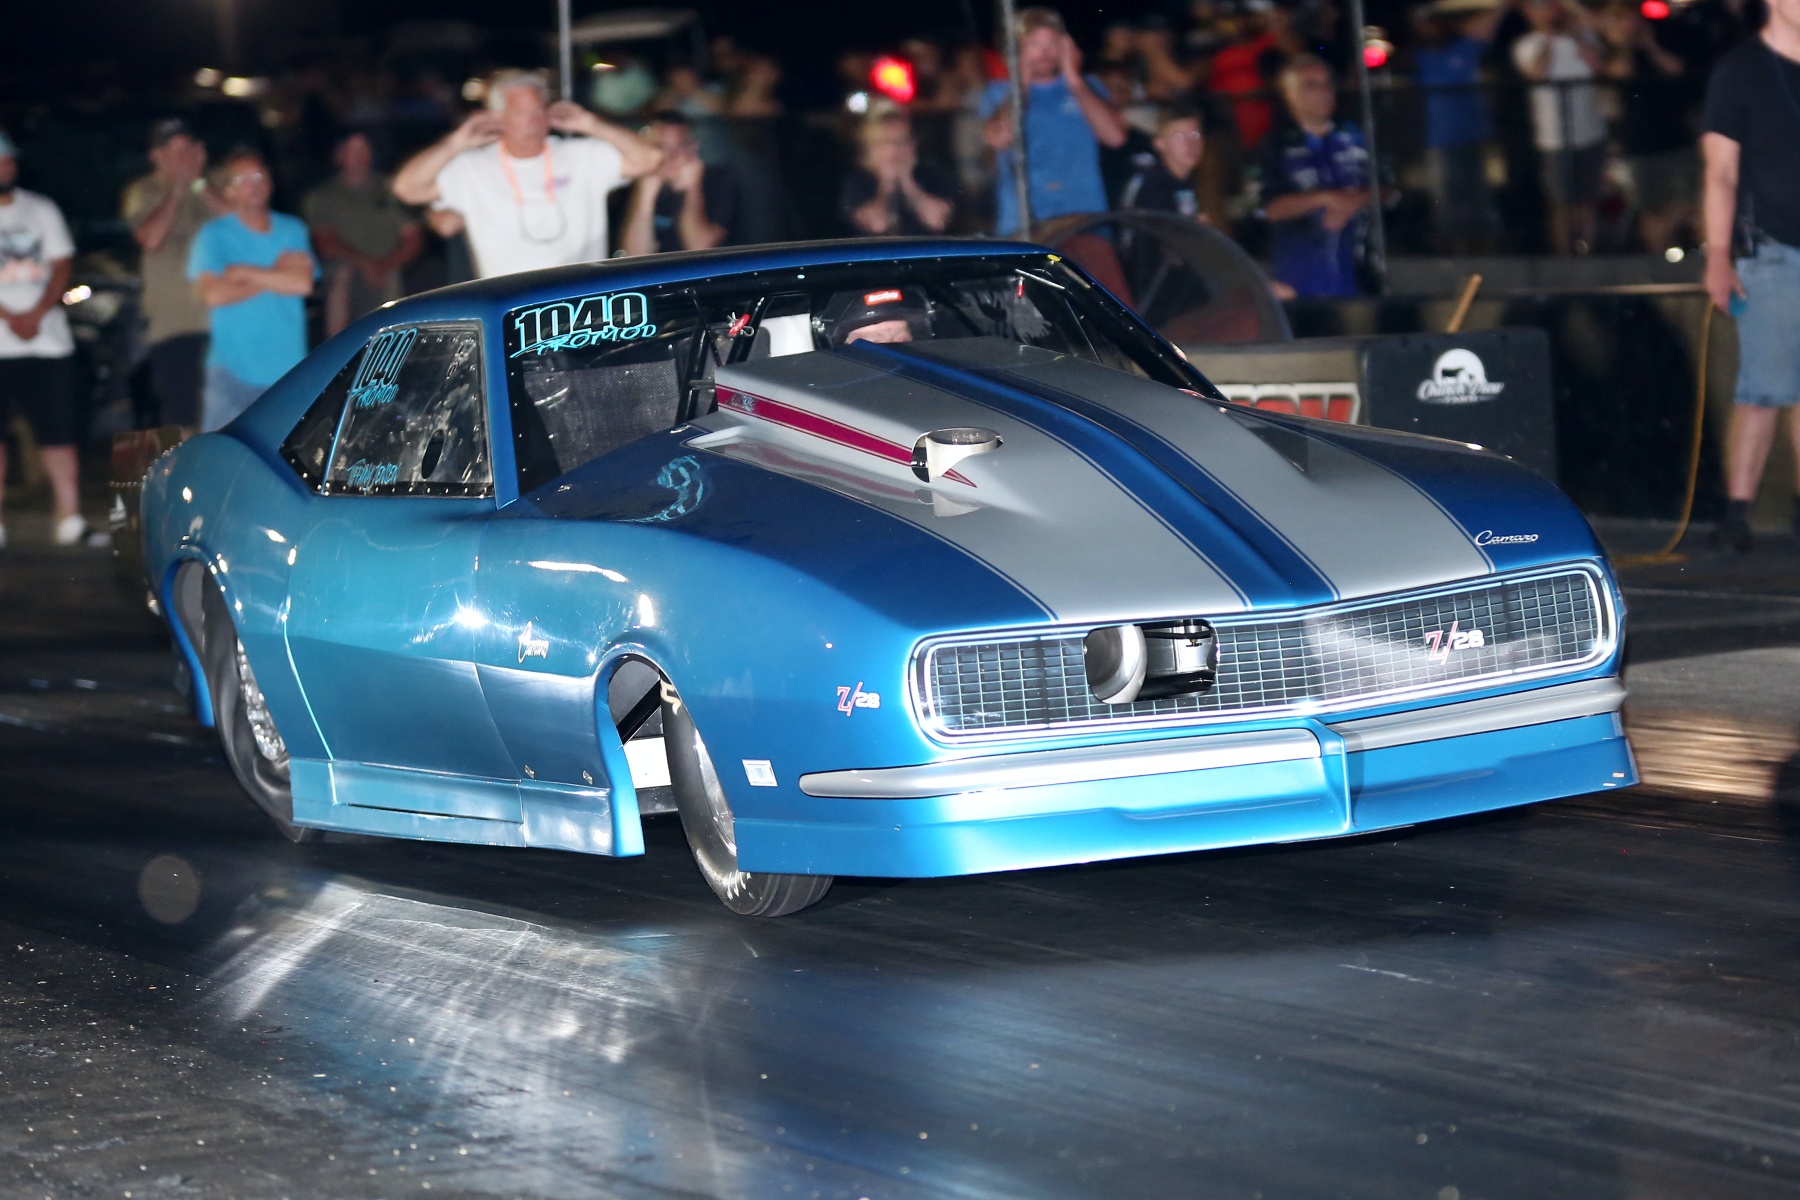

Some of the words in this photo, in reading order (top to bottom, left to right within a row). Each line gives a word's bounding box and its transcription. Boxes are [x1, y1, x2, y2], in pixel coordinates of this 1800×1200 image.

[515, 292, 648, 351] 1040
[352, 327, 419, 392] 1040
[1475, 530, 1539, 546] Camaro
[1425, 620, 1485, 665] Z/28
[837, 681, 880, 717] Z/28
